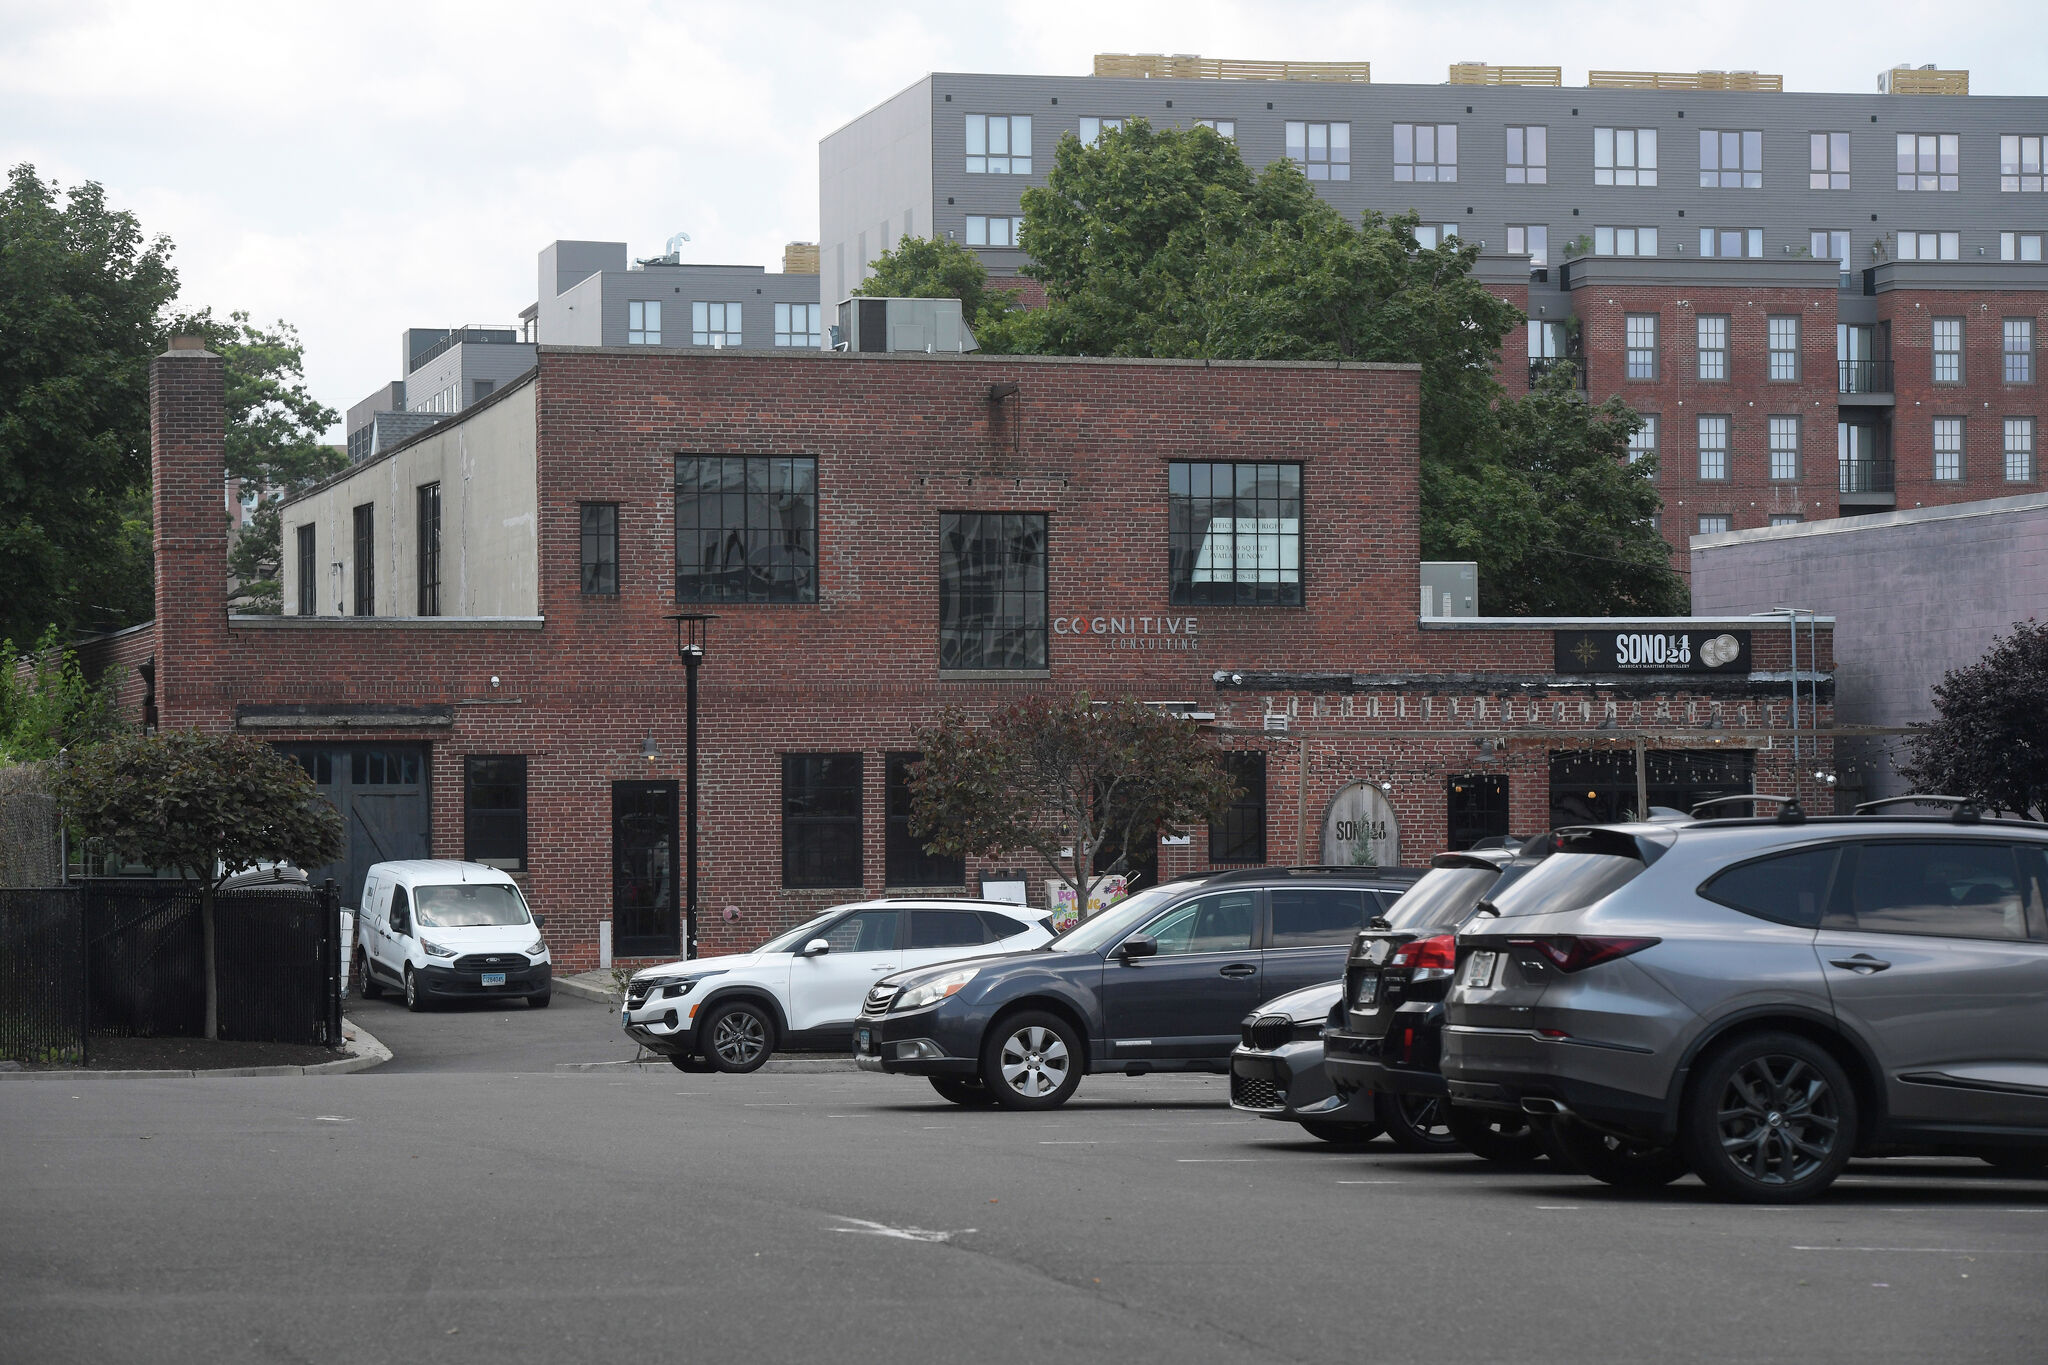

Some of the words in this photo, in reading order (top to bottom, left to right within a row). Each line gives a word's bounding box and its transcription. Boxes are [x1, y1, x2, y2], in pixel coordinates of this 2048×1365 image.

[1053, 616, 1198, 635] COGNITIVE
[1111, 638, 1198, 650] CONSULTING
[1617, 634, 1666, 664] SONO
[1071, 898, 1101, 911] Lve
